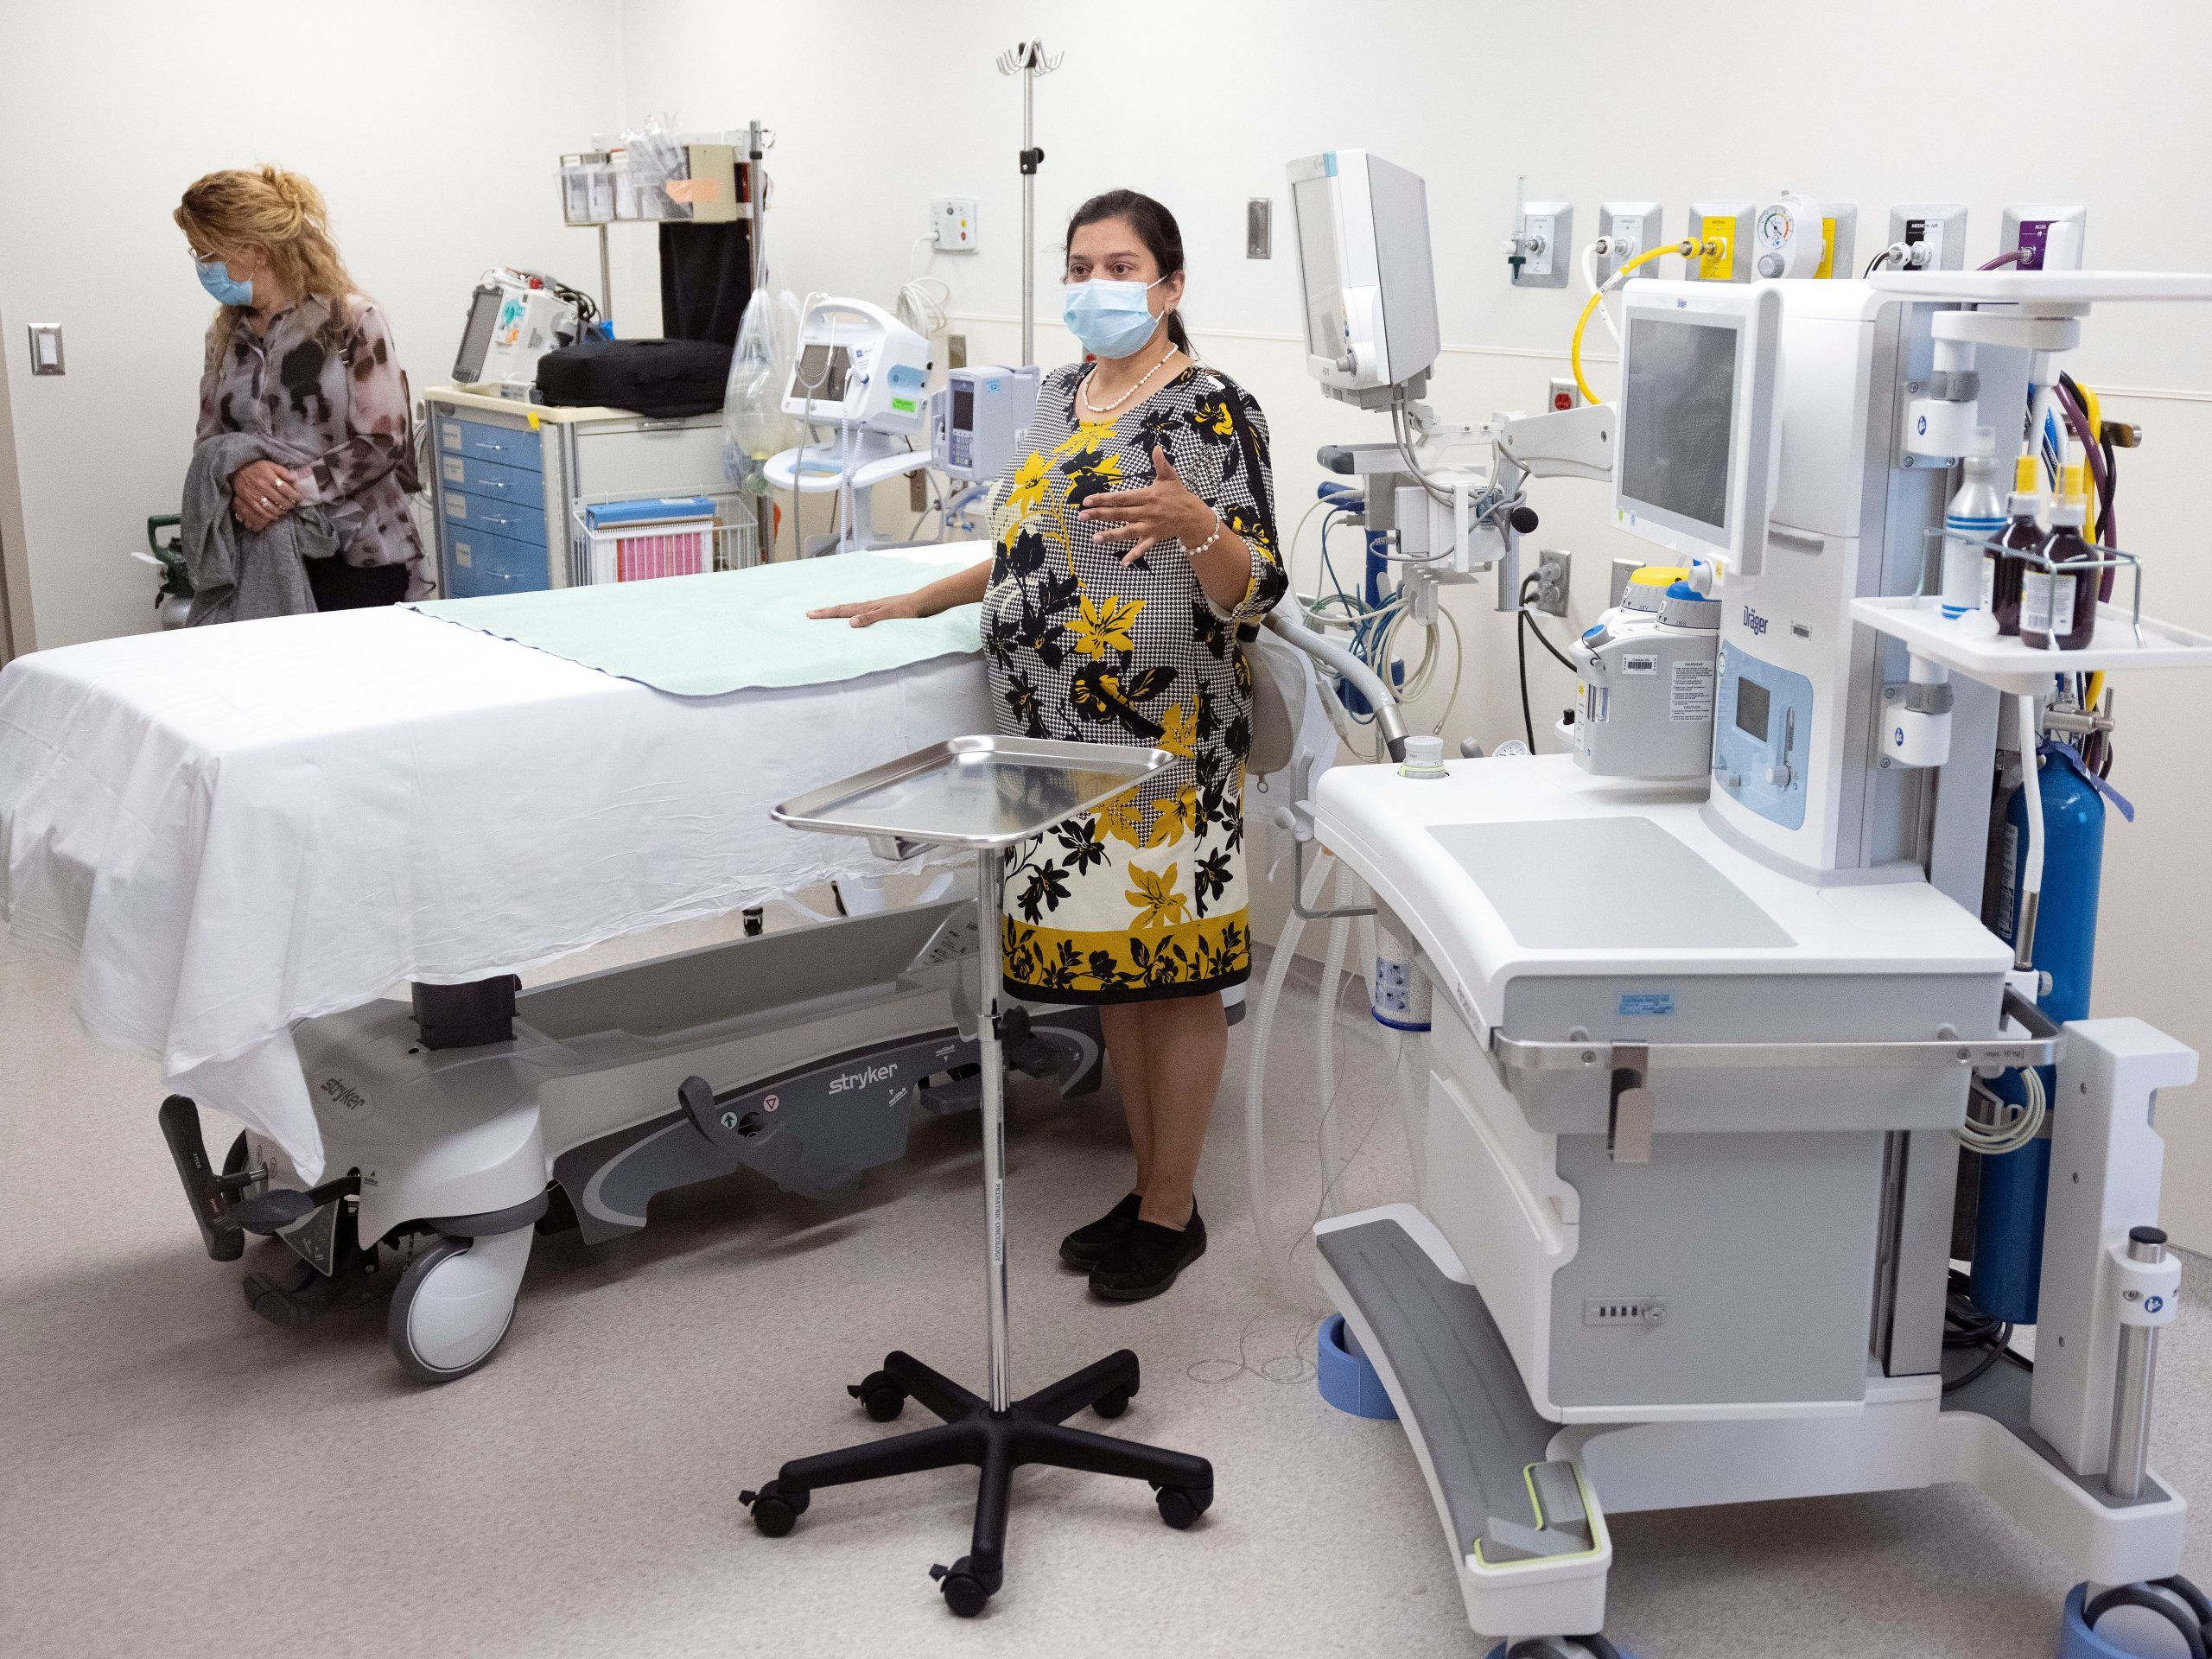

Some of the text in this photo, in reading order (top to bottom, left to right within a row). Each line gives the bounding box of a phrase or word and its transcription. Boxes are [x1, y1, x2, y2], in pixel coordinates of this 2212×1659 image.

[1743, 605, 1769, 636] Dräger
[321, 1077, 365, 1110] stryker
[828, 1063, 899, 1096] stryker
